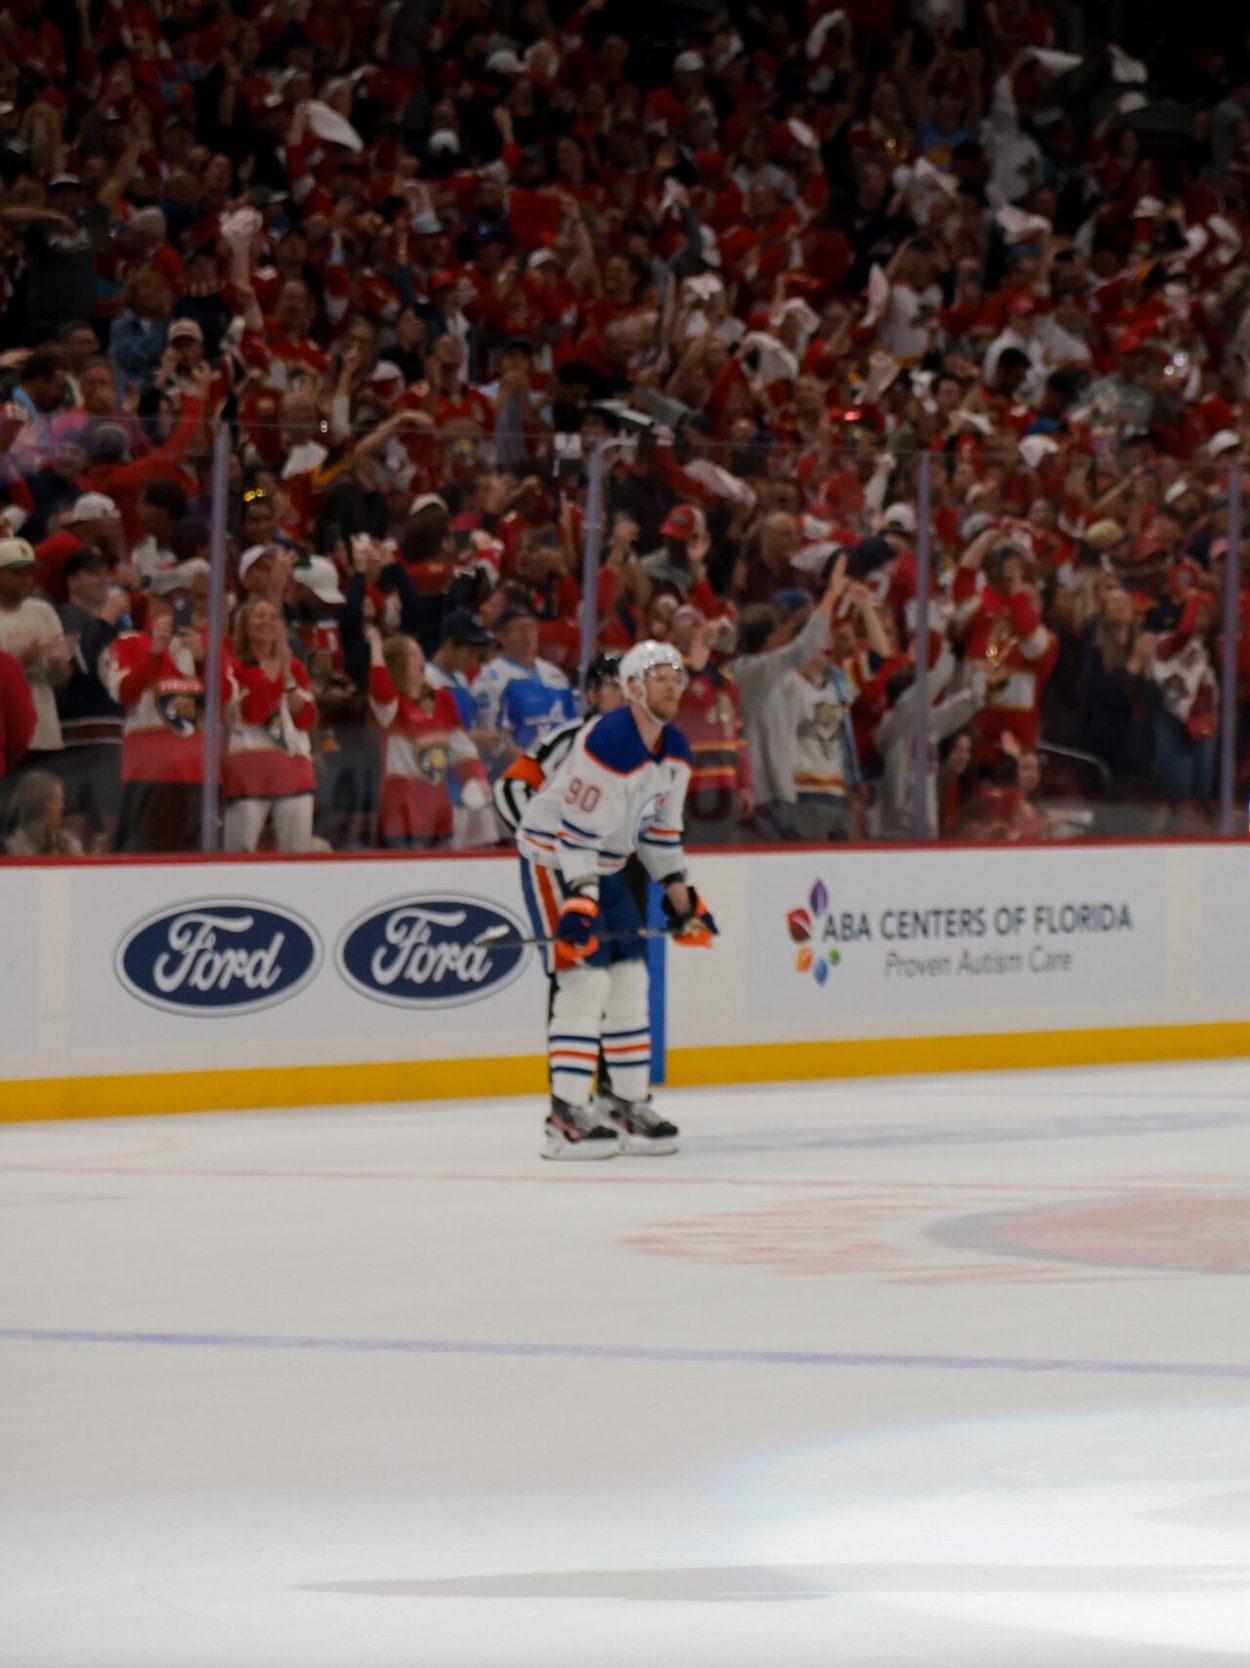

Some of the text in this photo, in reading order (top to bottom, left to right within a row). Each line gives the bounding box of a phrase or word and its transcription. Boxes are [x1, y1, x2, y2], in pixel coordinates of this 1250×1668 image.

[566, 776, 602, 813] 90
[822, 903, 1134, 943] ABA CENTERS OF FLORIDA
[153, 912, 285, 992] Ford
[884, 945, 1073, 979] Proven Autism Care
